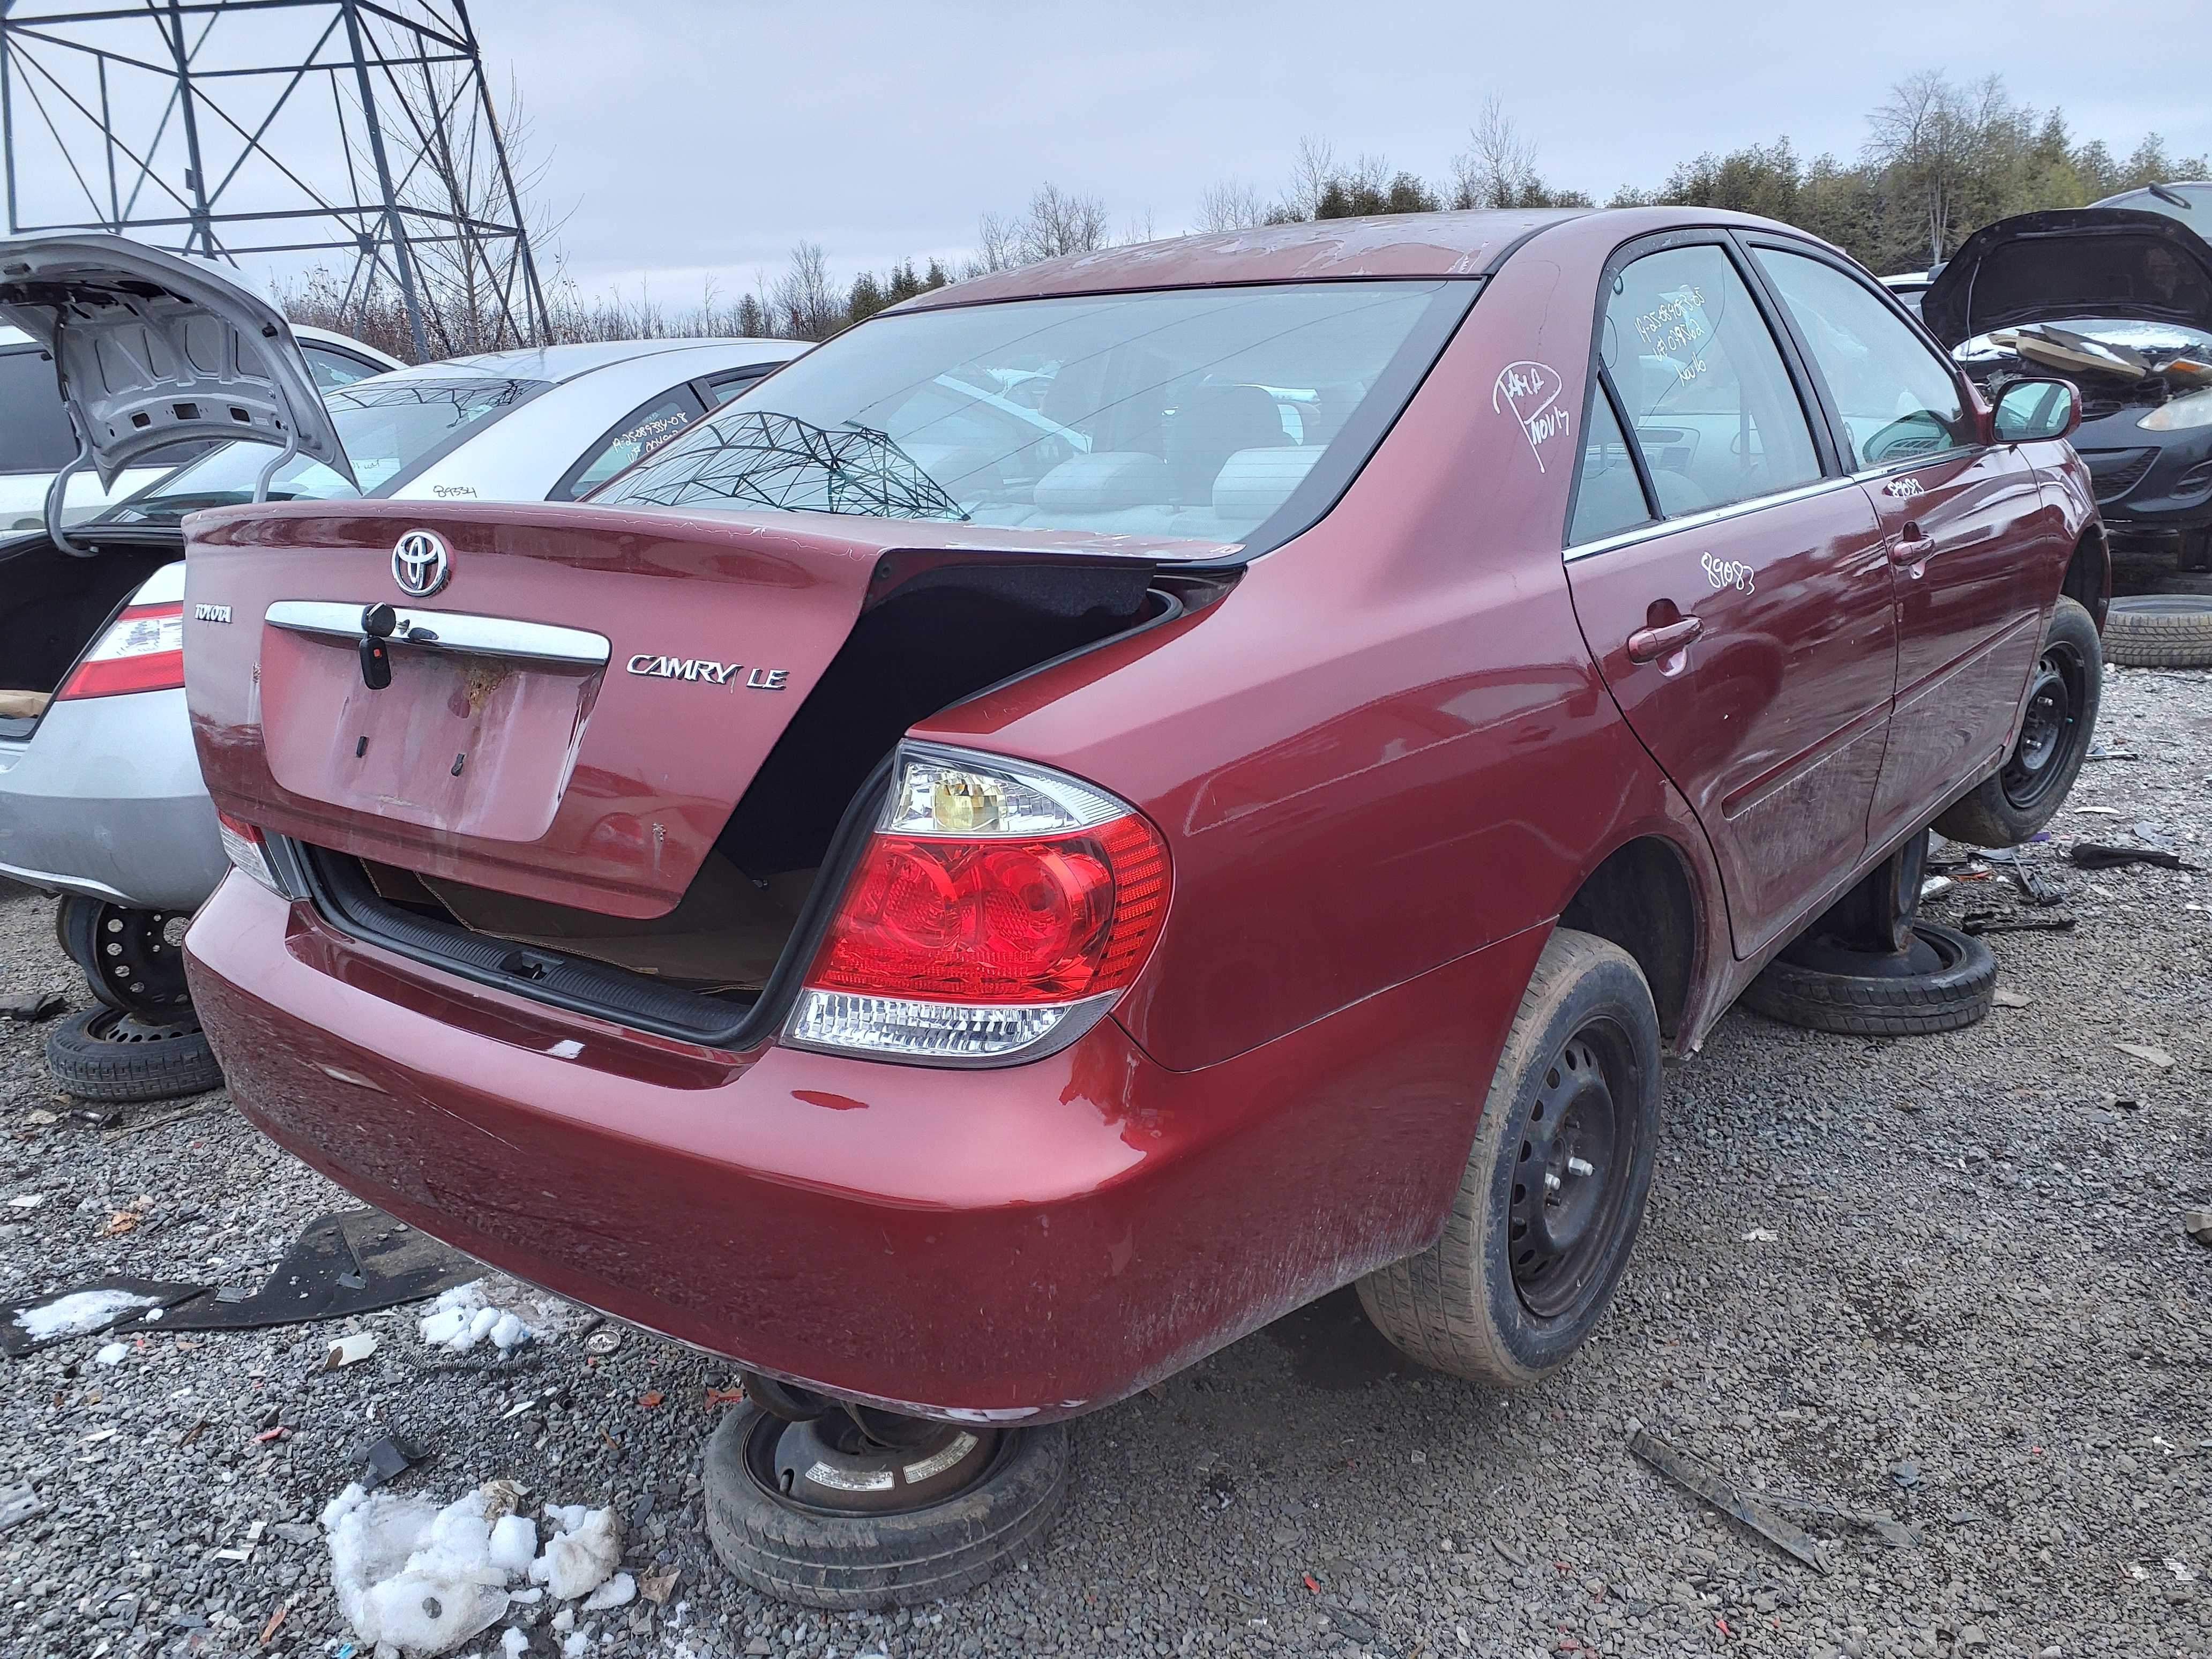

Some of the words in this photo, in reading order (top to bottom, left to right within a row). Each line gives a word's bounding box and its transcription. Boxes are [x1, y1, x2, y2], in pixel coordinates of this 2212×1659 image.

[1701, 551, 1755, 595] 89083
[195, 603, 232, 623] TOYOTA
[626, 654, 745, 685] CAMRY
[746, 668, 790, 690] LE
